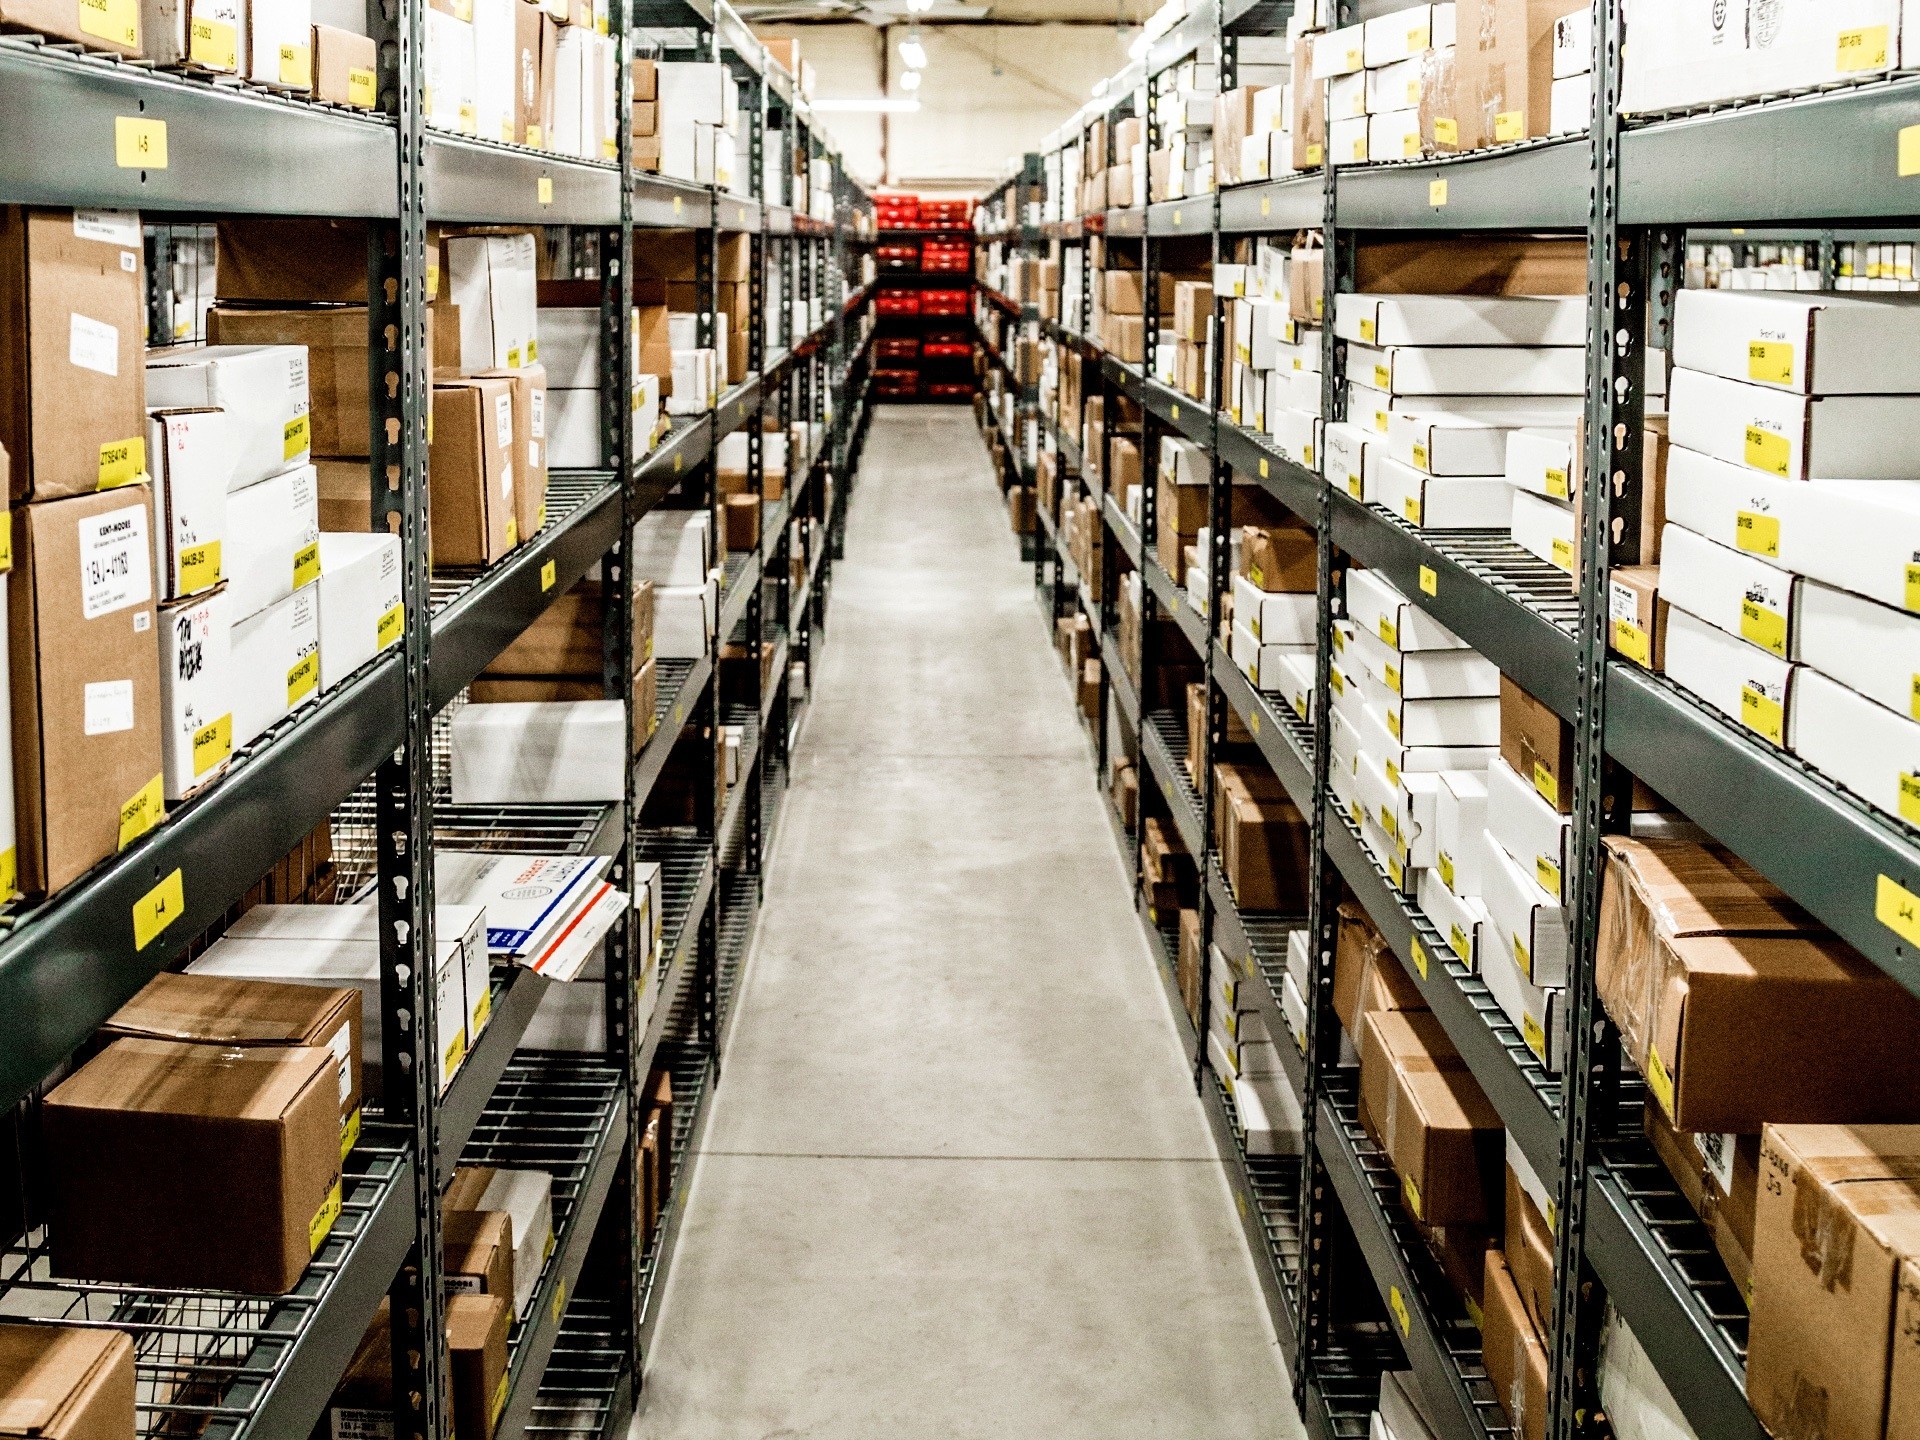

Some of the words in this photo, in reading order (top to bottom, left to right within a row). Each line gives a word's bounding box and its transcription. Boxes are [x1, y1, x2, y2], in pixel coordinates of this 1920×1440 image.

[138, 134, 148, 152] I-5
[1750, 346, 1765, 358] 9010B
[1737, 516, 1752, 529] 9010B
[155, 897, 165, 919] I-4
